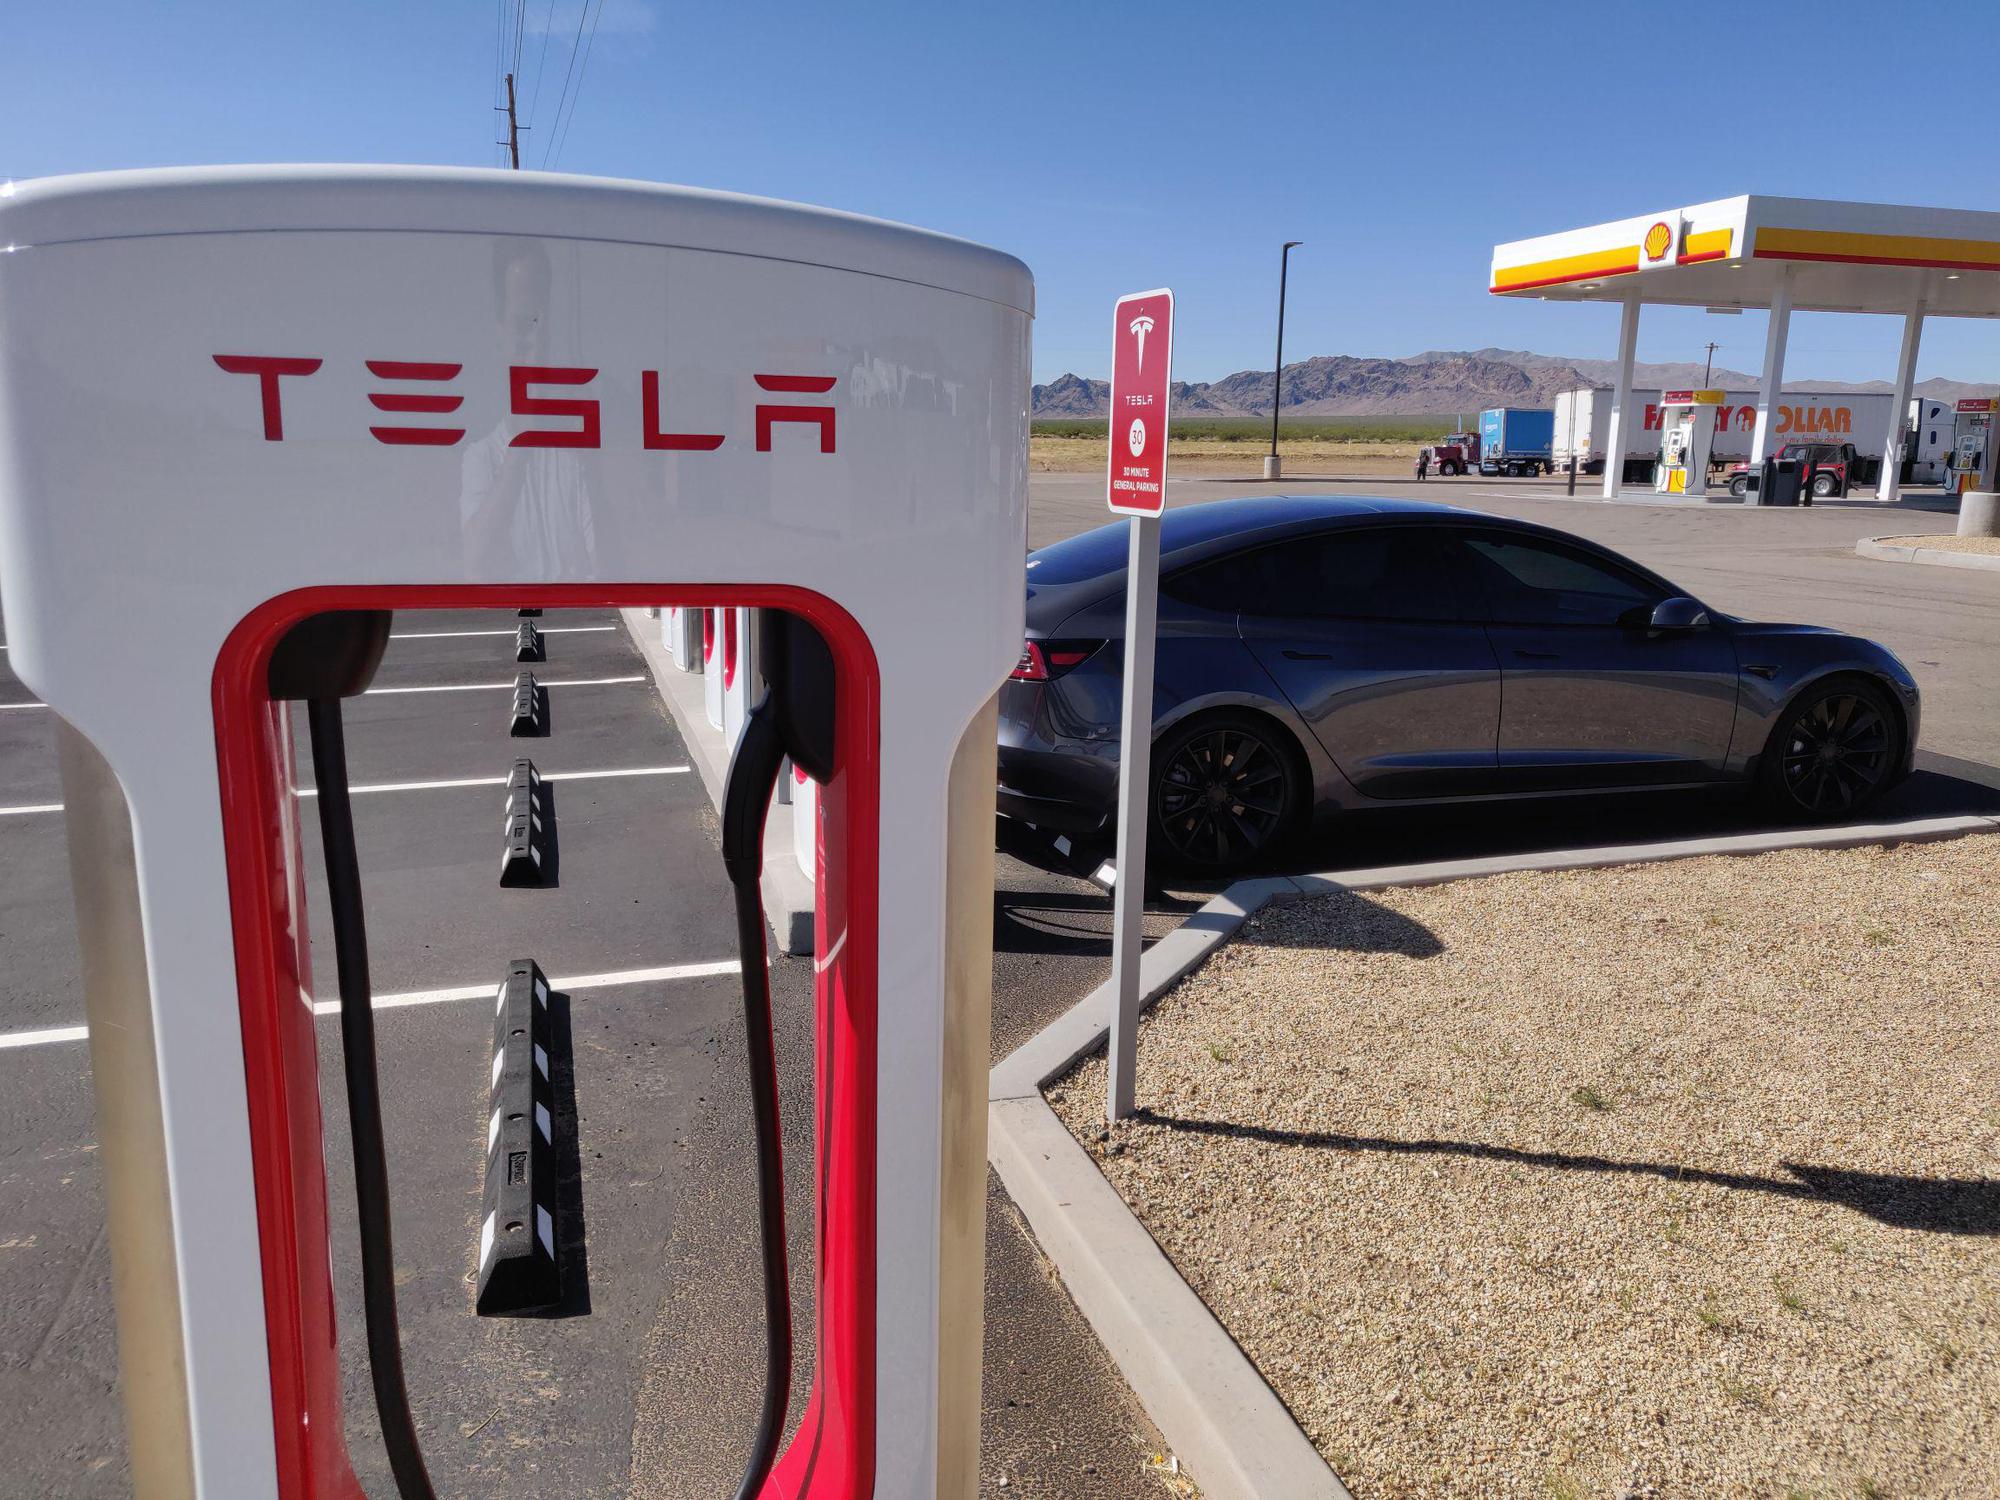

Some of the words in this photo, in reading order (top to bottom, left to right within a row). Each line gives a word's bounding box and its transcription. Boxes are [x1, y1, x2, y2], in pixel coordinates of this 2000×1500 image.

[212, 354, 837, 454] TESLA
[1125, 394, 1153, 406] TESLA
[1774, 405, 1852, 433] OLLAR
[1132, 430, 1143, 445] 30
[1123, 466, 1130, 476] 30
[1130, 466, 1149, 478] MINUTE
[1113, 480, 1136, 491] GENERAL
[1136, 481, 1159, 493] PARKING
